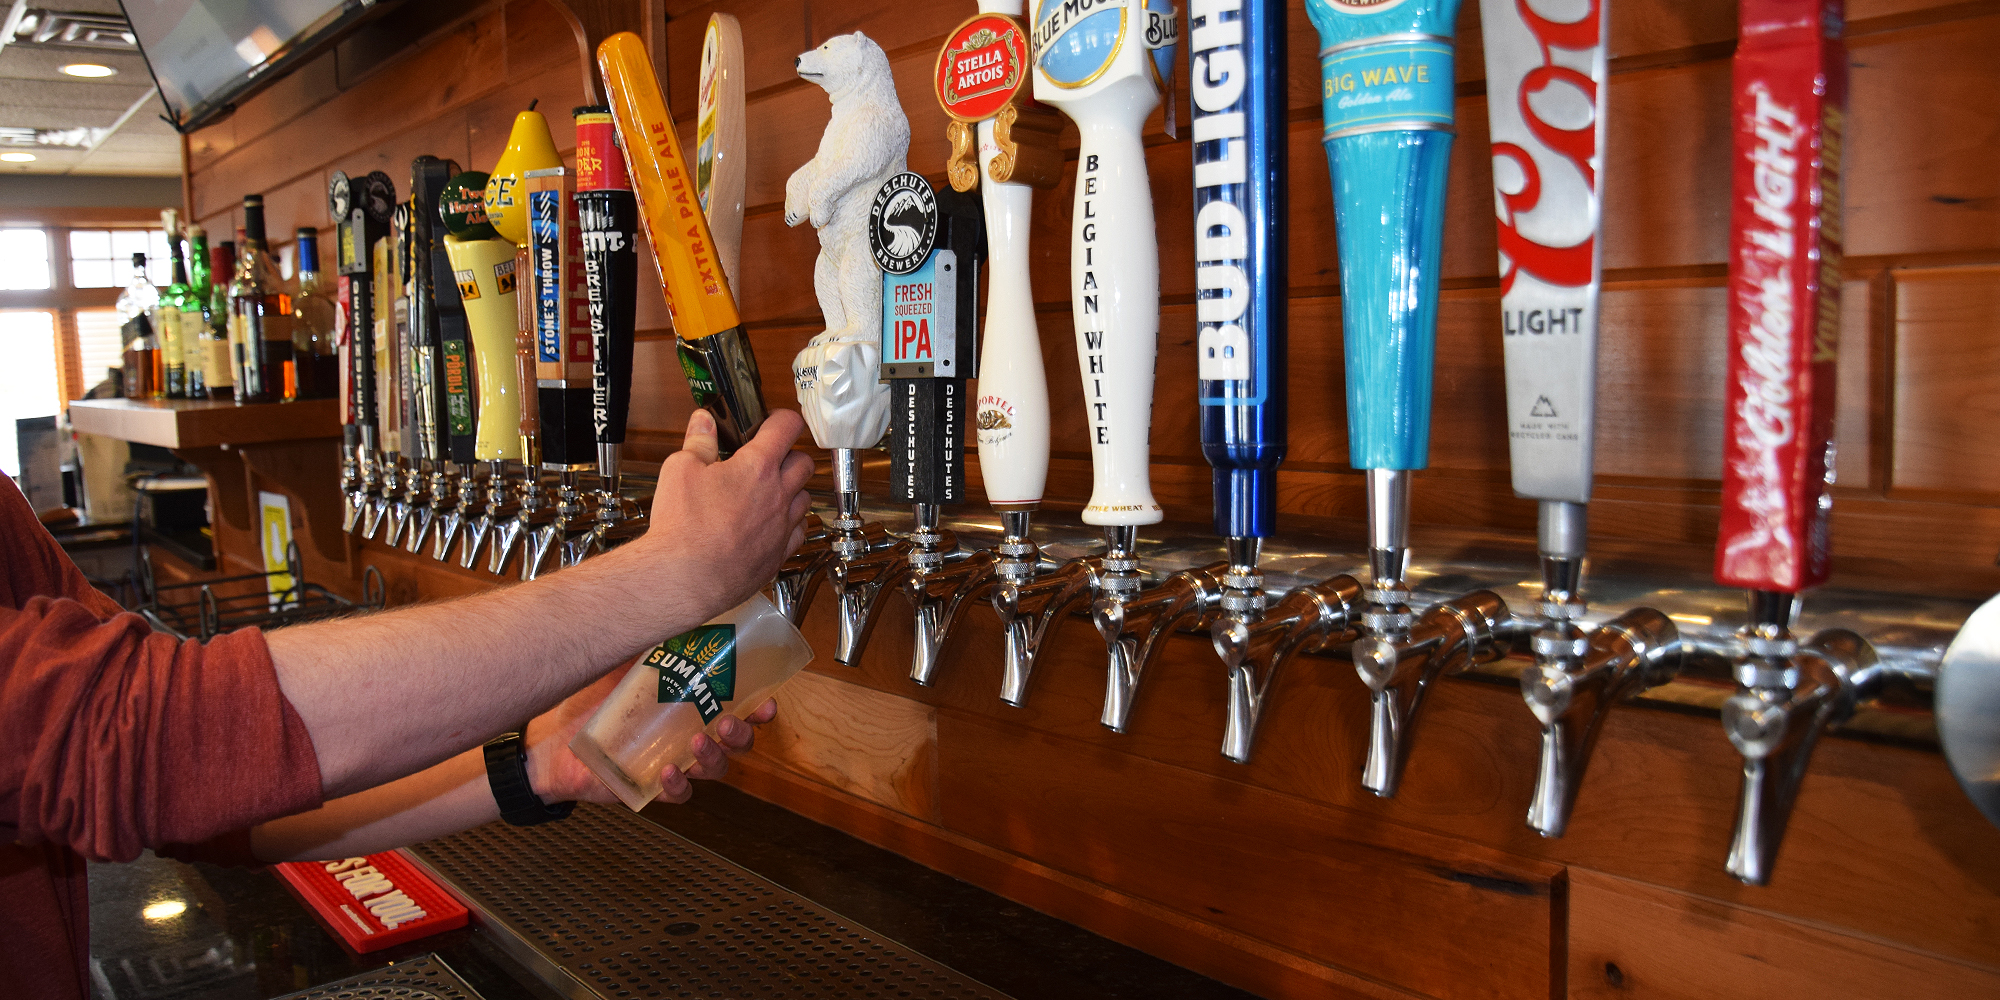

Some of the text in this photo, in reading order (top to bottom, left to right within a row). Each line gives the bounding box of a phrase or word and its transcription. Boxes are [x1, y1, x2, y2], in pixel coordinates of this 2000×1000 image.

[957, 50, 1003, 74] STELLA
[957, 65, 1004, 90] ARTOIS
[1325, 65, 1429, 98] BIG WAVE
[651, 122, 720, 296] EXTRA PALE ALE
[872, 175, 934, 217] DESCHUTES
[1191, 0, 1250, 381] BUD LIGH
[895, 283, 932, 303] FRESH
[1742, 91, 1796, 446] Golden LIGHT
[541, 248, 556, 355] STONE'S THROW
[894, 303, 932, 317] SQUEEZED
[1082, 154, 1110, 445] BELGIAN WHITE
[1503, 307, 1583, 336] LIGHT
[352, 280, 364, 420] DESCHUTES
[586, 260, 607, 436] BREWSTILLERY
[894, 318, 932, 360] IPA
[907, 383, 916, 499] DESCHUTES
[945, 384, 954, 500] DESCHUTES
[648, 650, 719, 716] SUMMIT
[661, 675, 686, 699] BREWING
[334, 865, 394, 901] FOR
